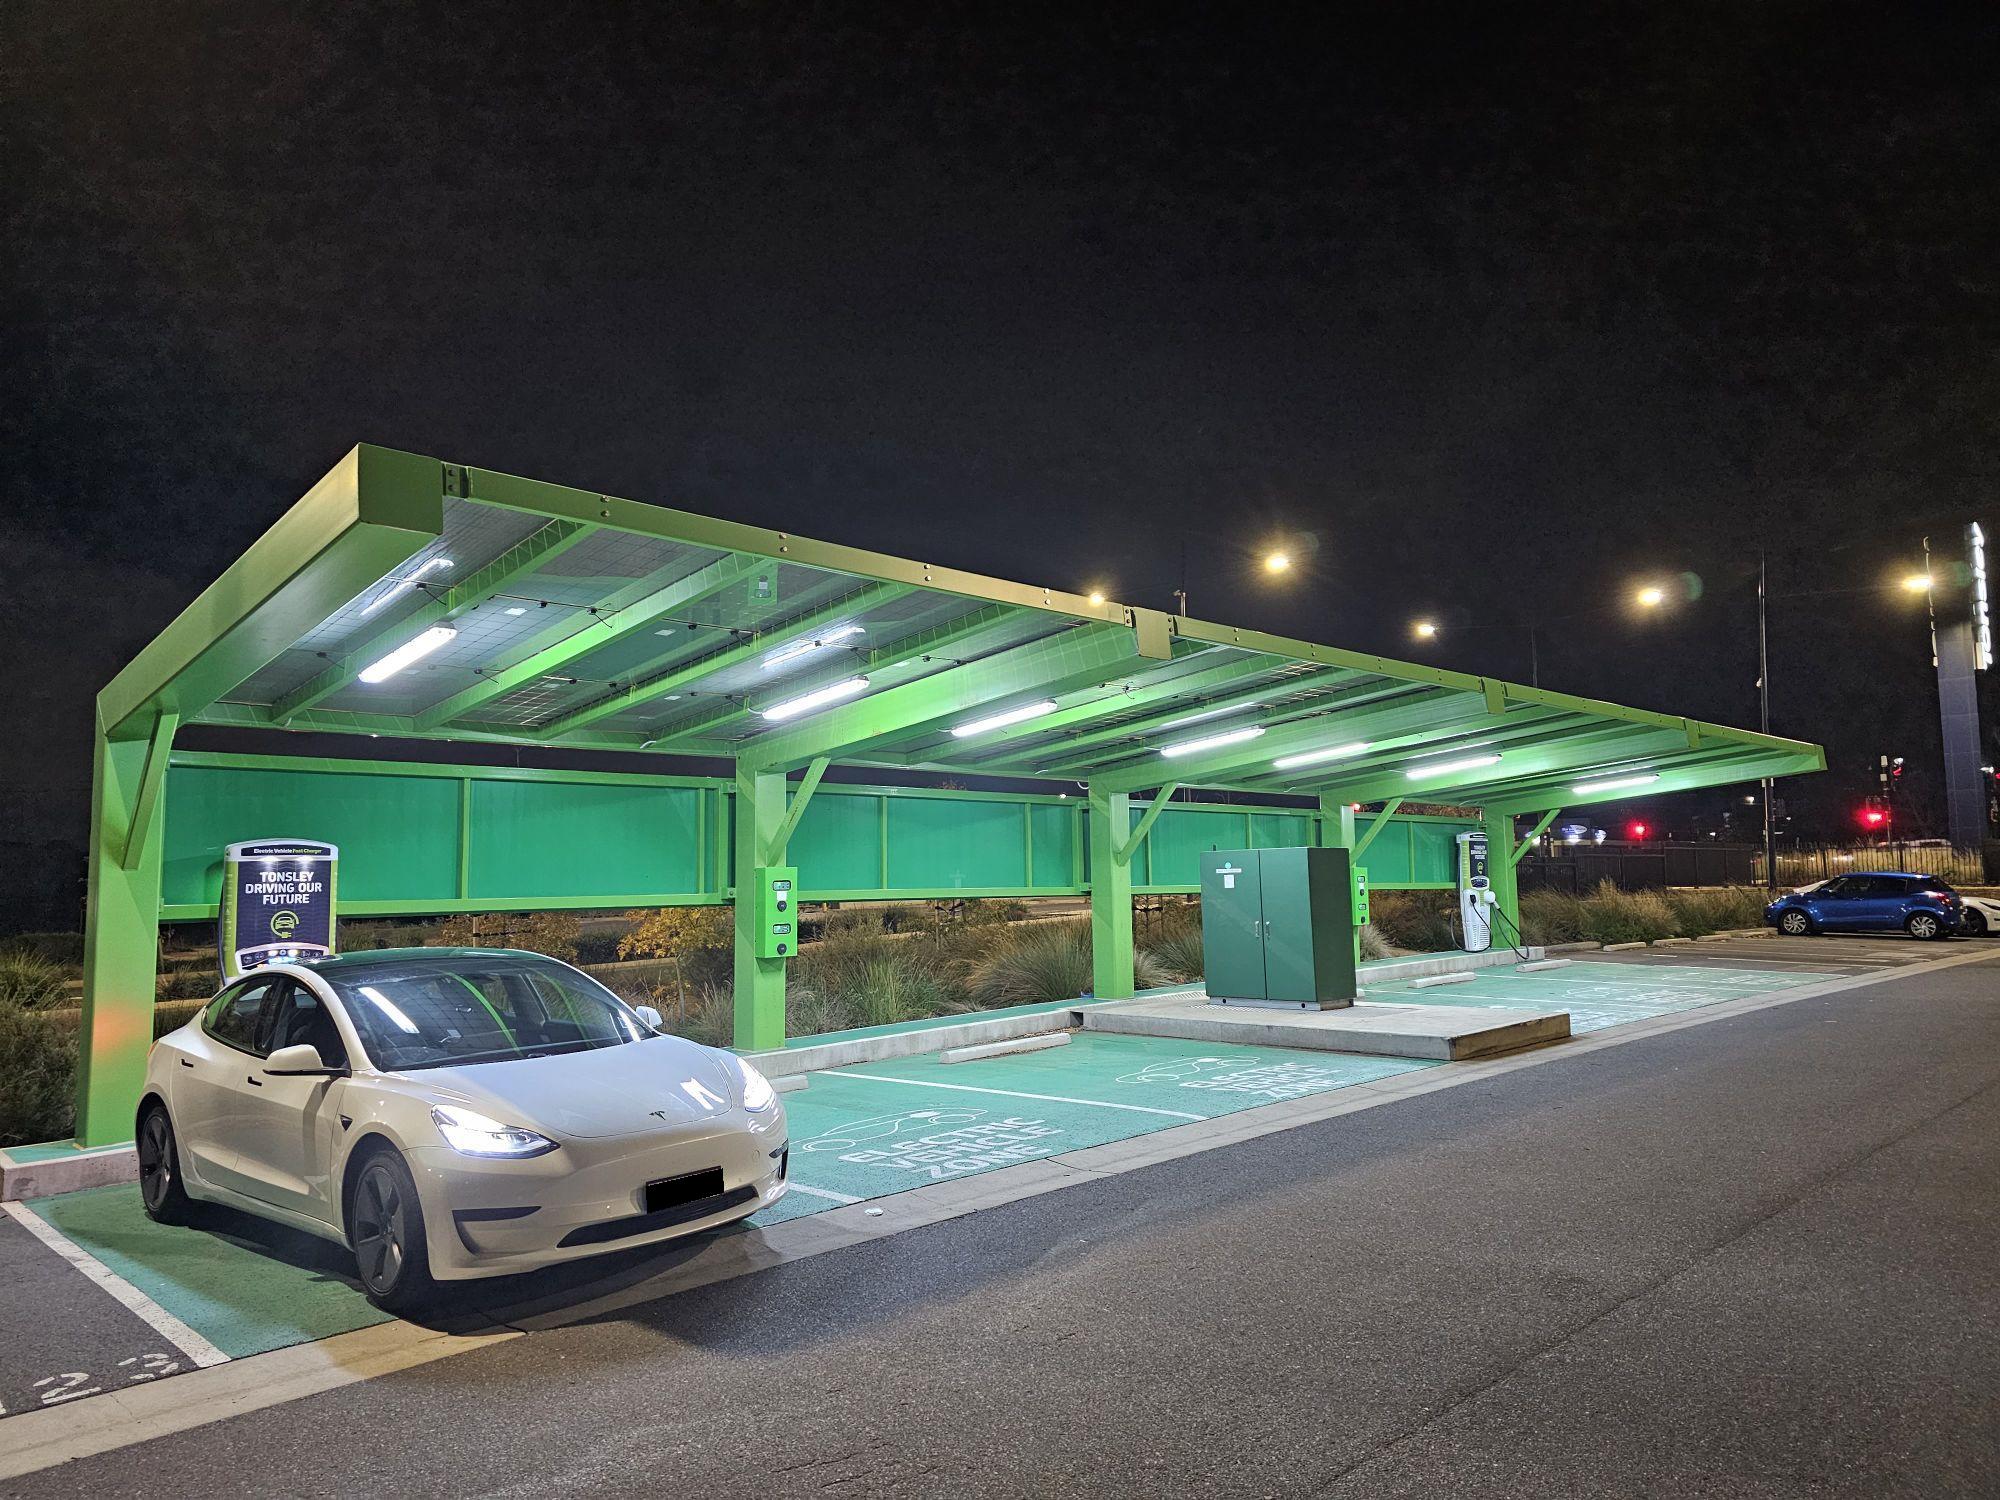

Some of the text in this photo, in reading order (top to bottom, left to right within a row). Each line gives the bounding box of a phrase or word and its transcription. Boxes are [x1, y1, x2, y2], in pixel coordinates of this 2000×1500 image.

[245, 882, 322, 894] DRIVING OUR
[260, 871, 314, 882] TONSLEY
[262, 893, 310, 905] FUTURE
[838, 1117, 1045, 1163] ELECTRIC
[869, 1126, 1064, 1168] VEHICLE
[911, 1143, 1051, 1179] ZONE
